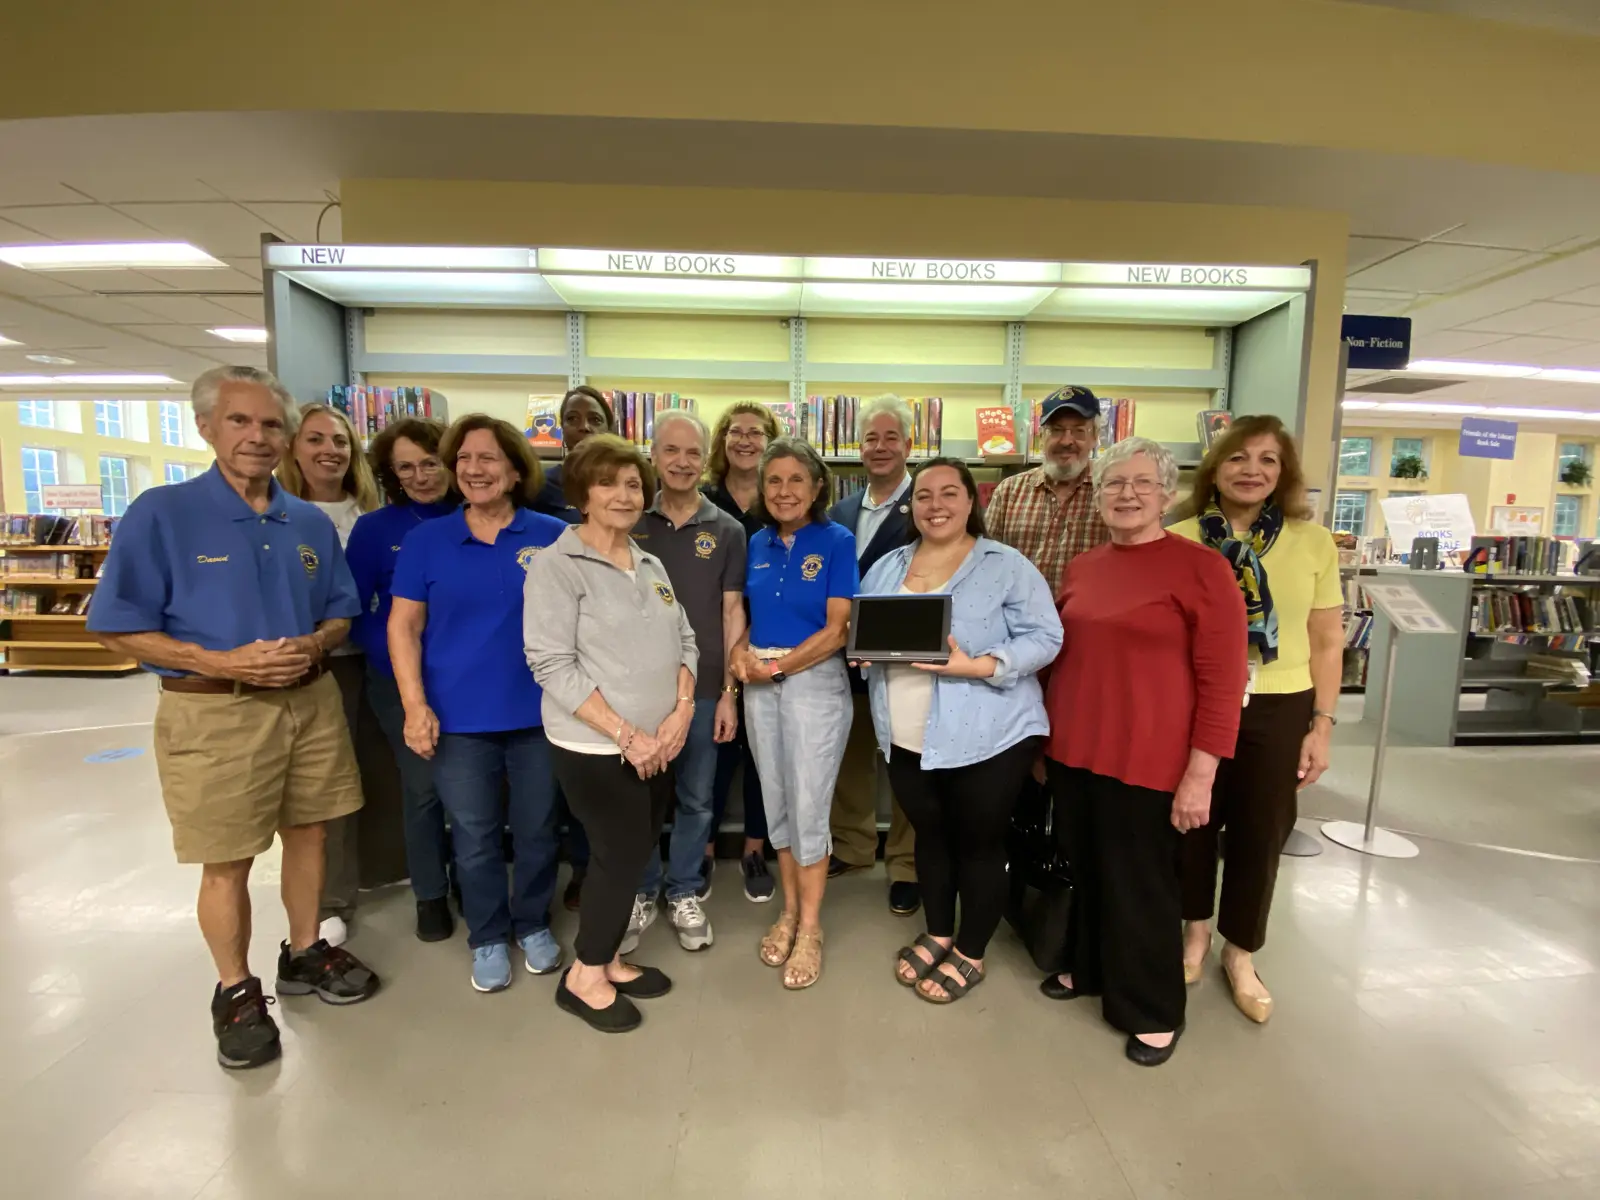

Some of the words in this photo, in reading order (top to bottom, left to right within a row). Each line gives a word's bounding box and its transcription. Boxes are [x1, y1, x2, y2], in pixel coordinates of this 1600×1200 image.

[301, 247, 345, 264] NEW
[608, 254, 653, 271] NEW
[664, 256, 736, 273] BOOKS
[872, 261, 916, 278] NEW
[926, 263, 996, 280] BOOKS
[1128, 267, 1171, 283] NEW
[1180, 268, 1248, 285] BOOKS
[1346, 335, 1404, 349] Non-Fiction
[1418, 530, 1453, 539] BOOKS
[1437, 540, 1461, 550] SALE
